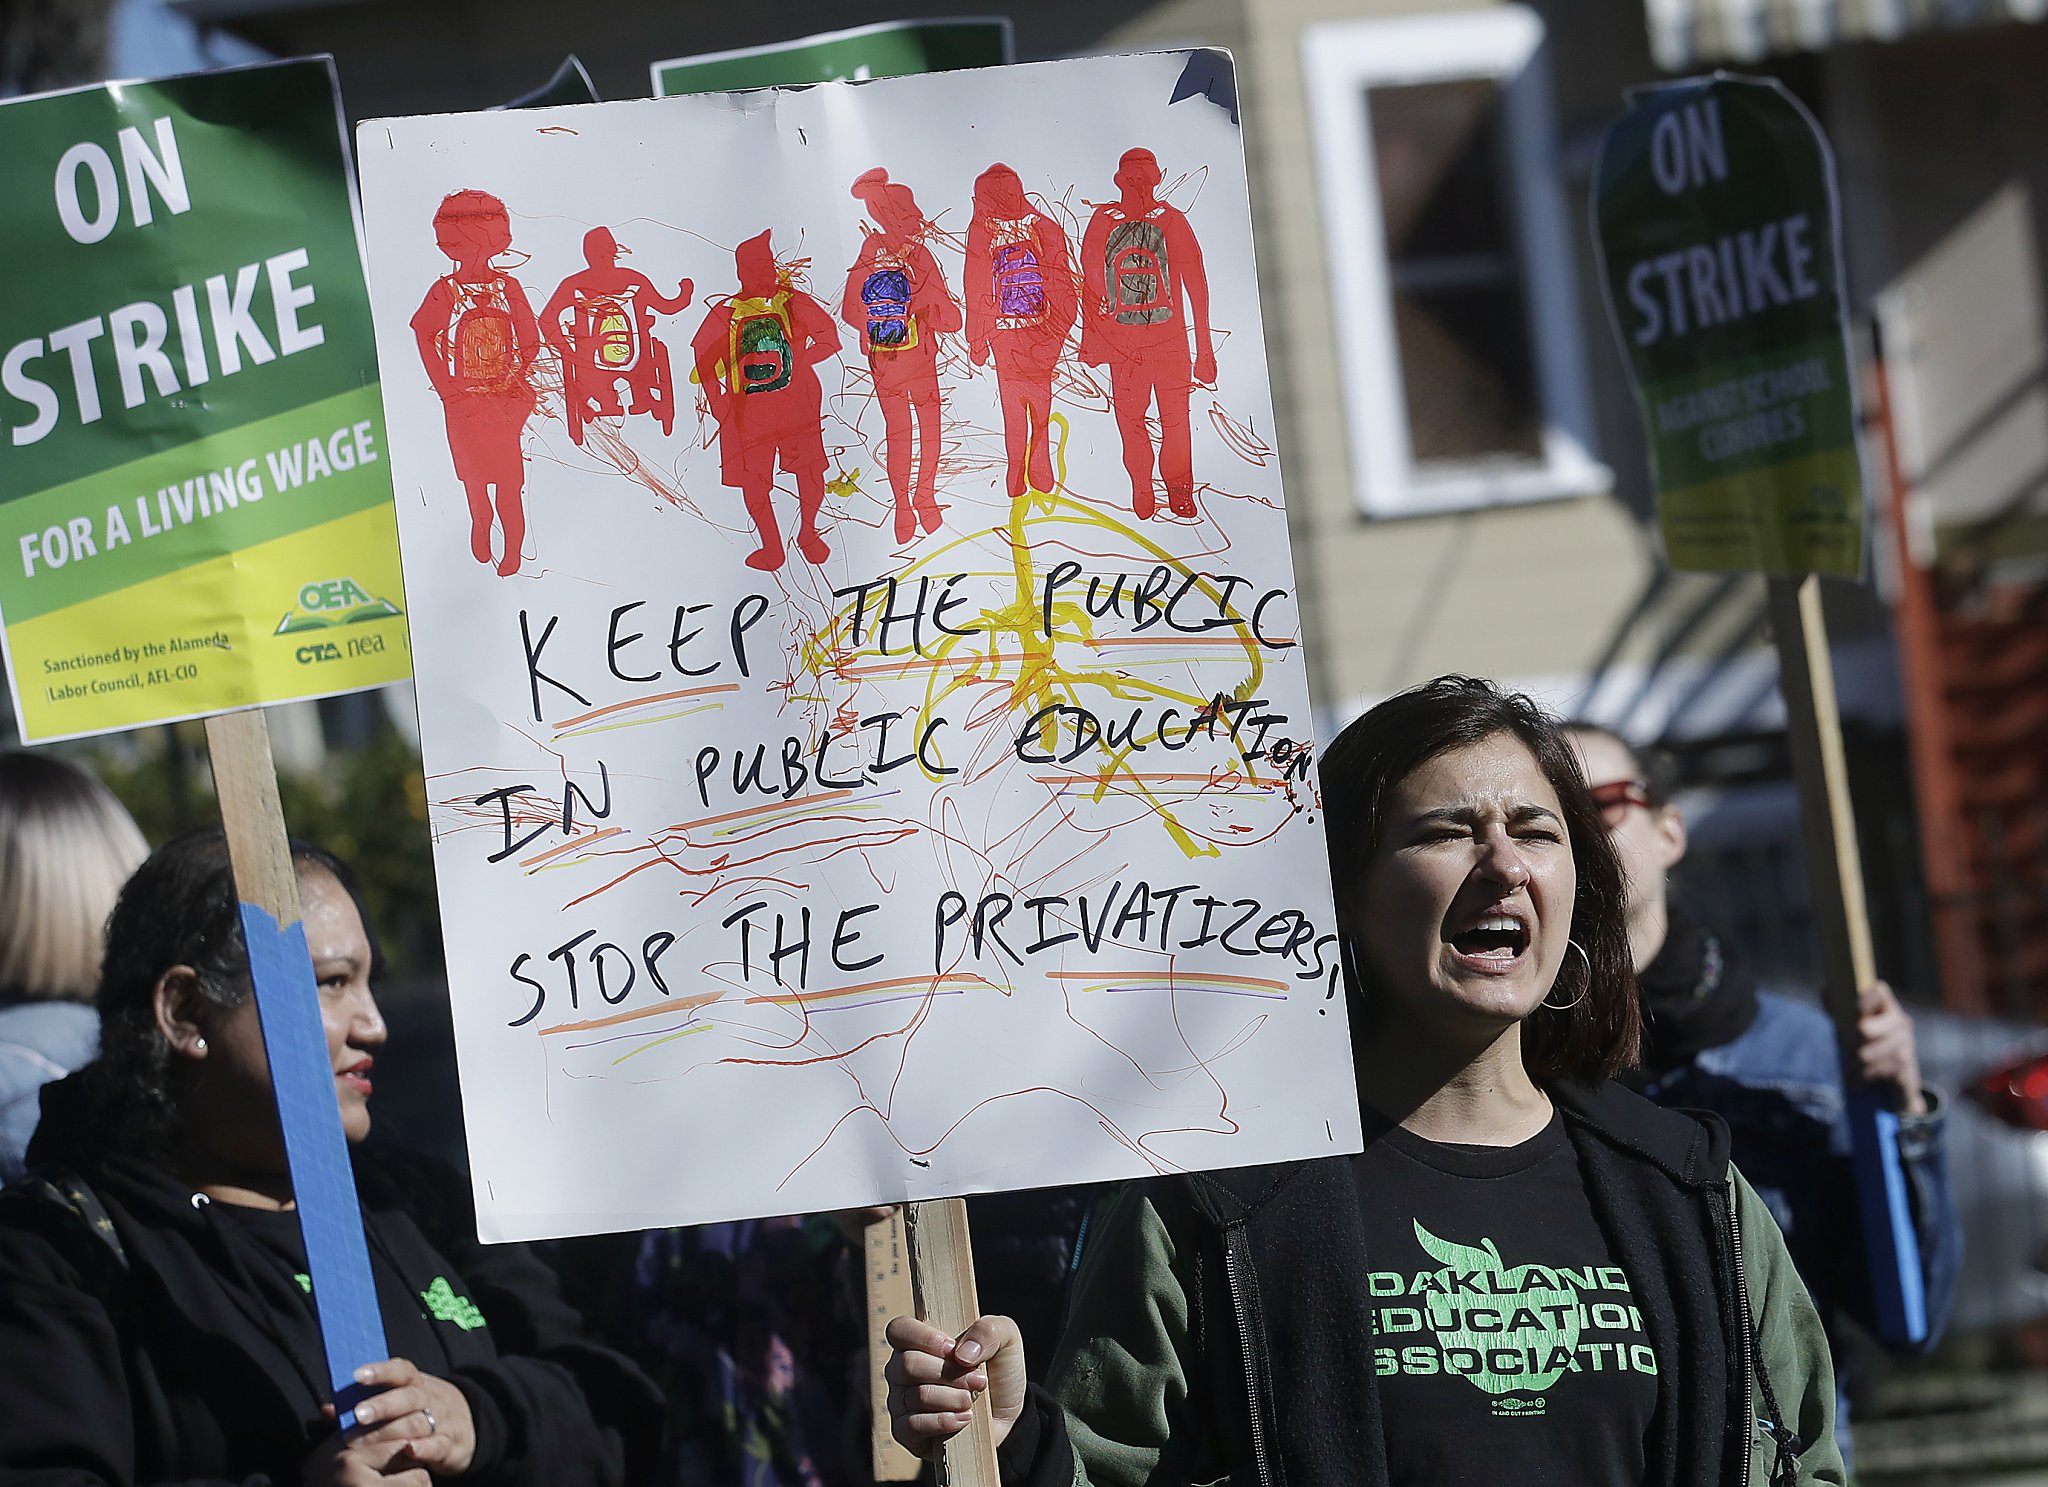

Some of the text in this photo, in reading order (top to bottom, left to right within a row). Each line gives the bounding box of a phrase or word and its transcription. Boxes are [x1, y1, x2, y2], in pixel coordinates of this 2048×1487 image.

[54, 116, 192, 245] ON
[1651, 99, 1728, 195] ON
[1627, 215, 1819, 347] STRIKE
[1, 247, 326, 447] STRIKE
[19, 420, 379, 578] FOR A LIVING WAGE
[44, 631, 229, 674] Sanctioned by the Alameda
[295, 641, 342, 665] CTA
[347, 632, 385, 659] nea
[299, 576, 375, 612] OEA
[519, 561, 1296, 722] KEEP THE PUBLIC
[49, 664, 198, 702] Labor Council, AFL-CIO
[478, 761, 610, 863] IN
[696, 712, 958, 805] PUBLIC
[509, 881, 1340, 1027] STOP THE PRIVATIZERS!
[1367, 1265, 1630, 1296] OAKLAND
